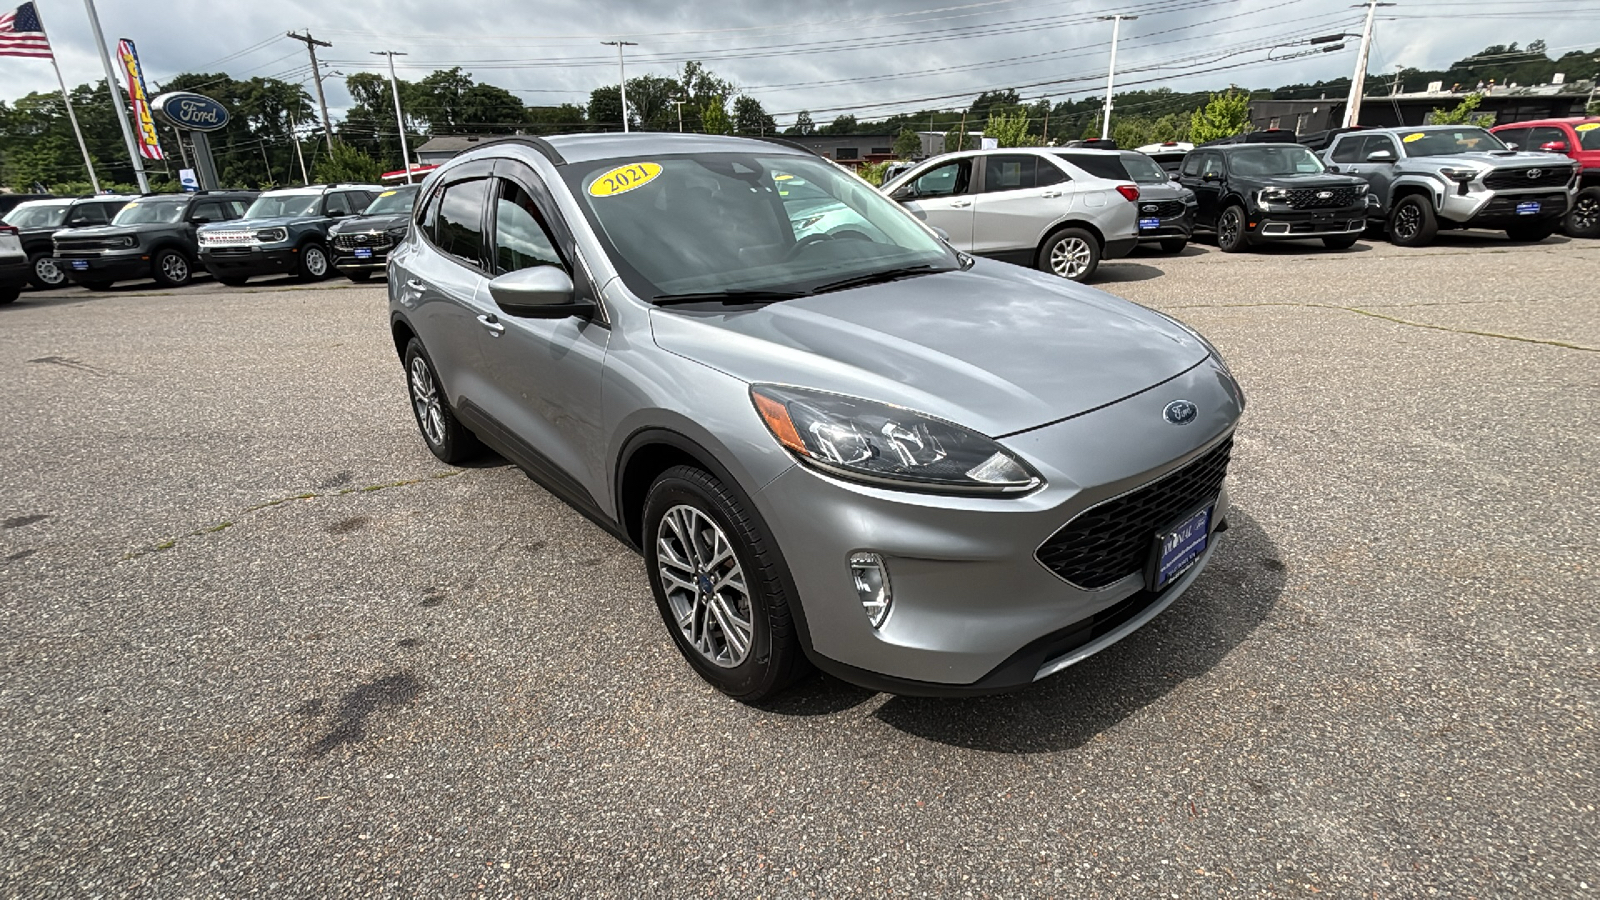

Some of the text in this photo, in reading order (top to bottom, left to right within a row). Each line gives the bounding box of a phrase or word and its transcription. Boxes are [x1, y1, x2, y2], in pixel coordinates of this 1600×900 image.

[180, 100, 218, 123] Ford
[603, 164, 651, 192] 2021
[1172, 404, 1191, 420] Ford
